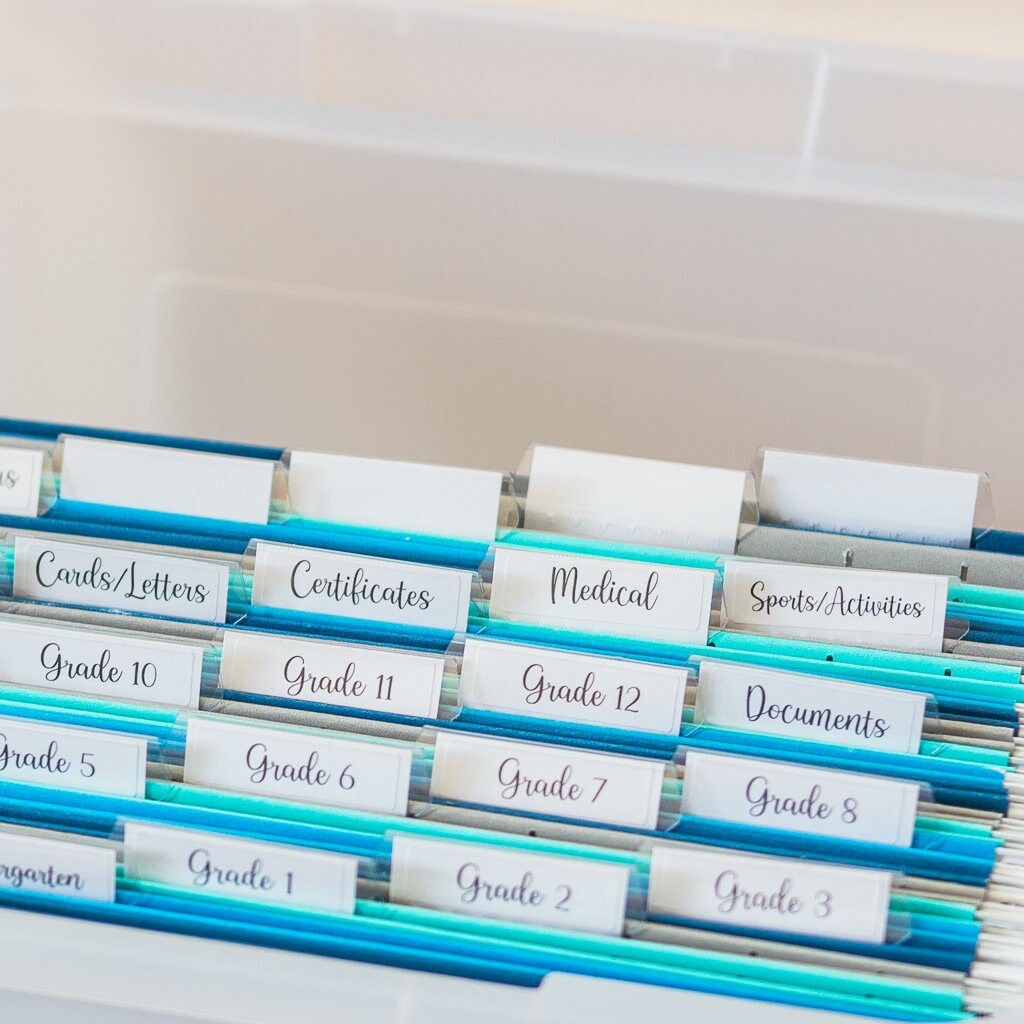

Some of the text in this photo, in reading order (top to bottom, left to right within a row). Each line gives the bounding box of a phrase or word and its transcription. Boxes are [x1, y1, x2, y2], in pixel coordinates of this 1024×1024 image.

[35, 550, 210, 603] Cards/Letters
[290, 559, 434, 610] Certificates
[551, 565, 658, 610] Medical
[750, 580, 926, 618] Sports/Activities
[40, 642, 157, 687] Grade 10
[284, 656, 394, 700] Grade 11
[523, 664, 641, 713] Grade 12
[746, 685, 890, 739] Documents
[80, 753, 96, 777] 5
[246, 743, 356, 789] Grade 6
[498, 758, 608, 803] Grade 7
[746, 776, 857, 823] Grade 8
[188, 849, 294, 895] Grade 1
[456, 864, 572, 909] Grade 2
[715, 871, 832, 918] Grade 3
